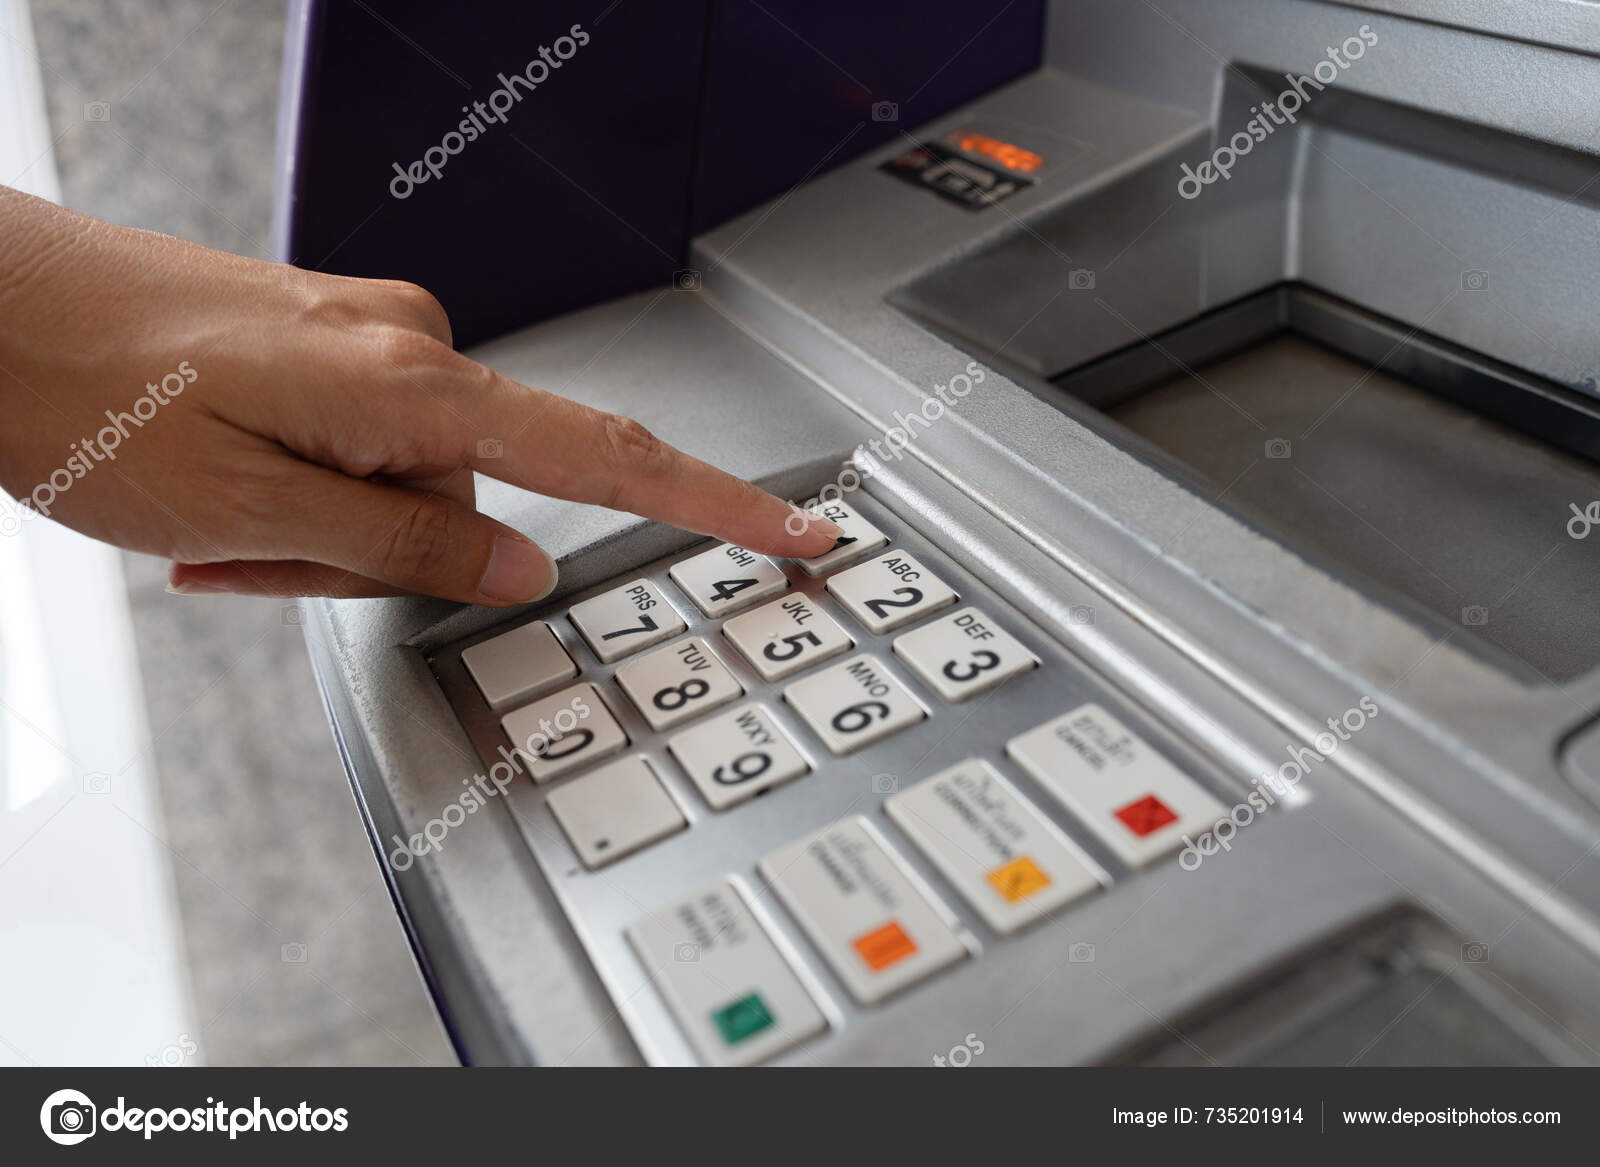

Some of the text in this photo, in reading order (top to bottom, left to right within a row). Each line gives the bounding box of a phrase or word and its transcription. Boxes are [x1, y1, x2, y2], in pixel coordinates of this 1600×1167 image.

[824, 506, 849, 523] QZ
[726, 546, 756, 568] GHI
[881, 556, 922, 584] ABC
[626, 585, 657, 611] PRS
[709, 578, 760, 602] 4
[863, 586, 924, 620] 2
[781, 600, 814, 626] JKL
[601, 614, 659, 642] 7
[953, 614, 995, 643] DEF
[676, 642, 712, 671] TUV
[762, 630, 823, 662] 5
[846, 662, 890, 698] MNO
[943, 650, 1002, 683] 3
[652, 678, 711, 711] 8
[735, 710, 776, 746] WXY
[831, 701, 891, 734] 6
[712, 752, 773, 786] 9
